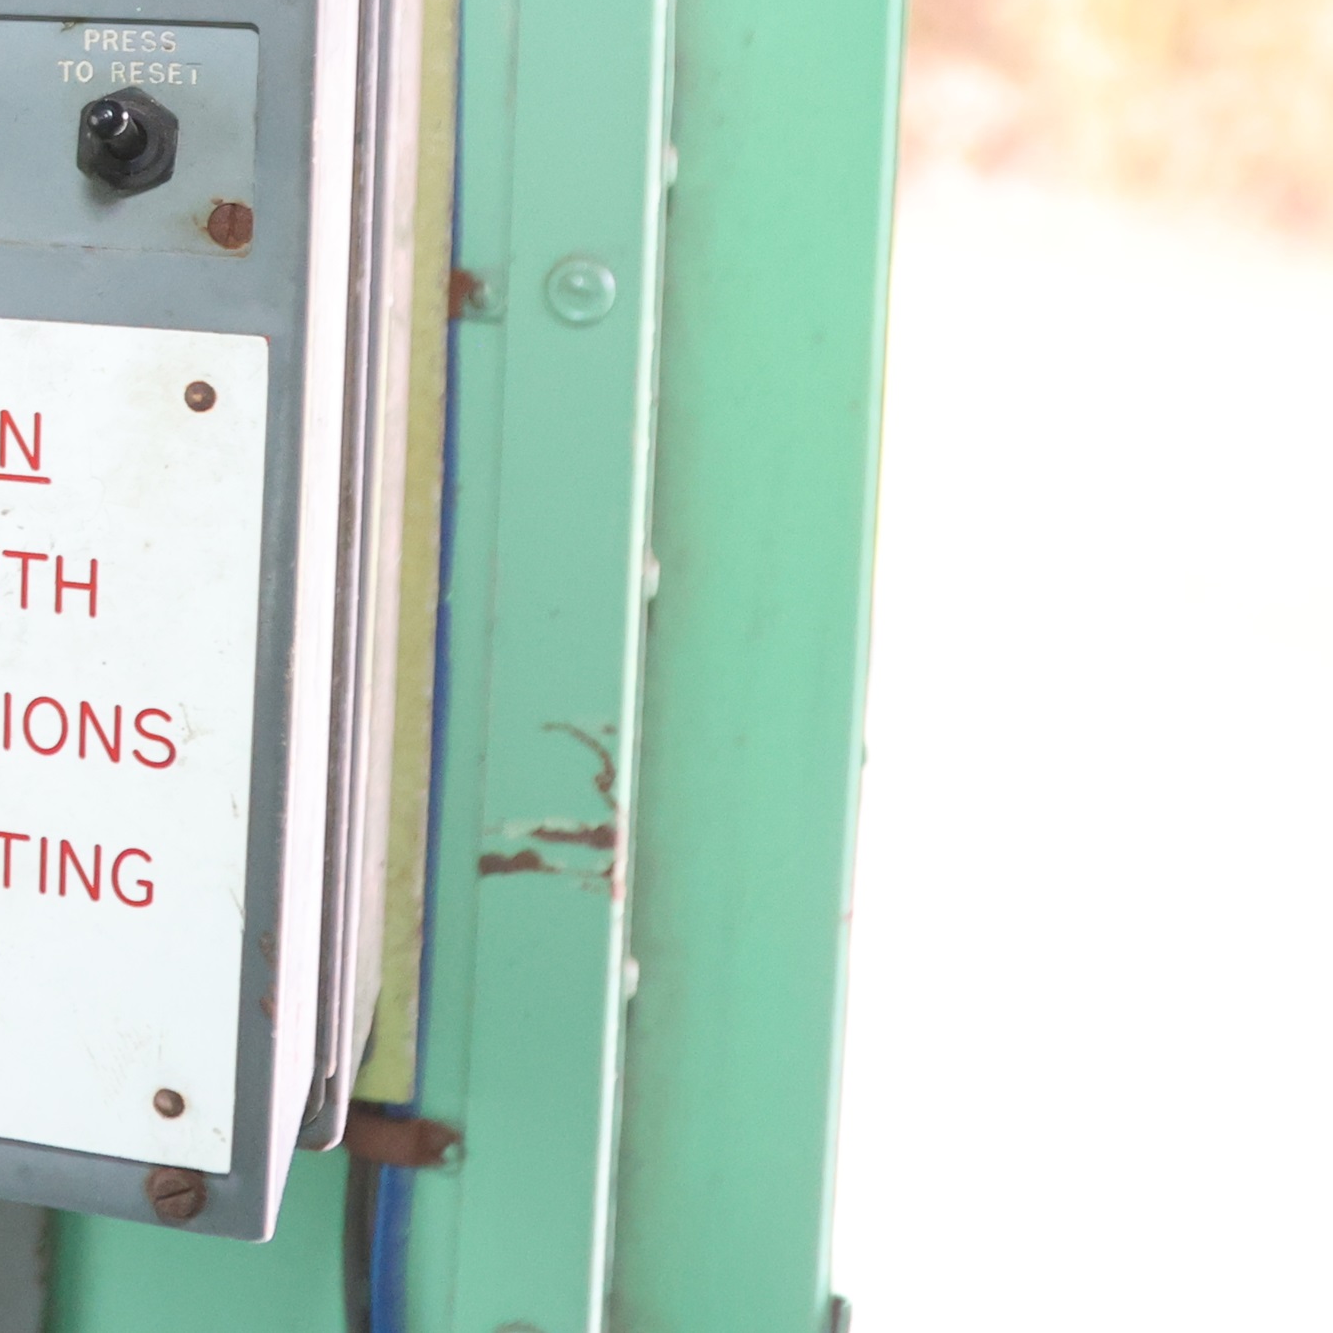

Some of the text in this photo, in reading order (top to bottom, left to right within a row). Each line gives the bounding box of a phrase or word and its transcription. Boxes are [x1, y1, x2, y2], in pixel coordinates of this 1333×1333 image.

[83, 28, 177, 54] PRESS
[57, 59, 203, 86] TO RESET
